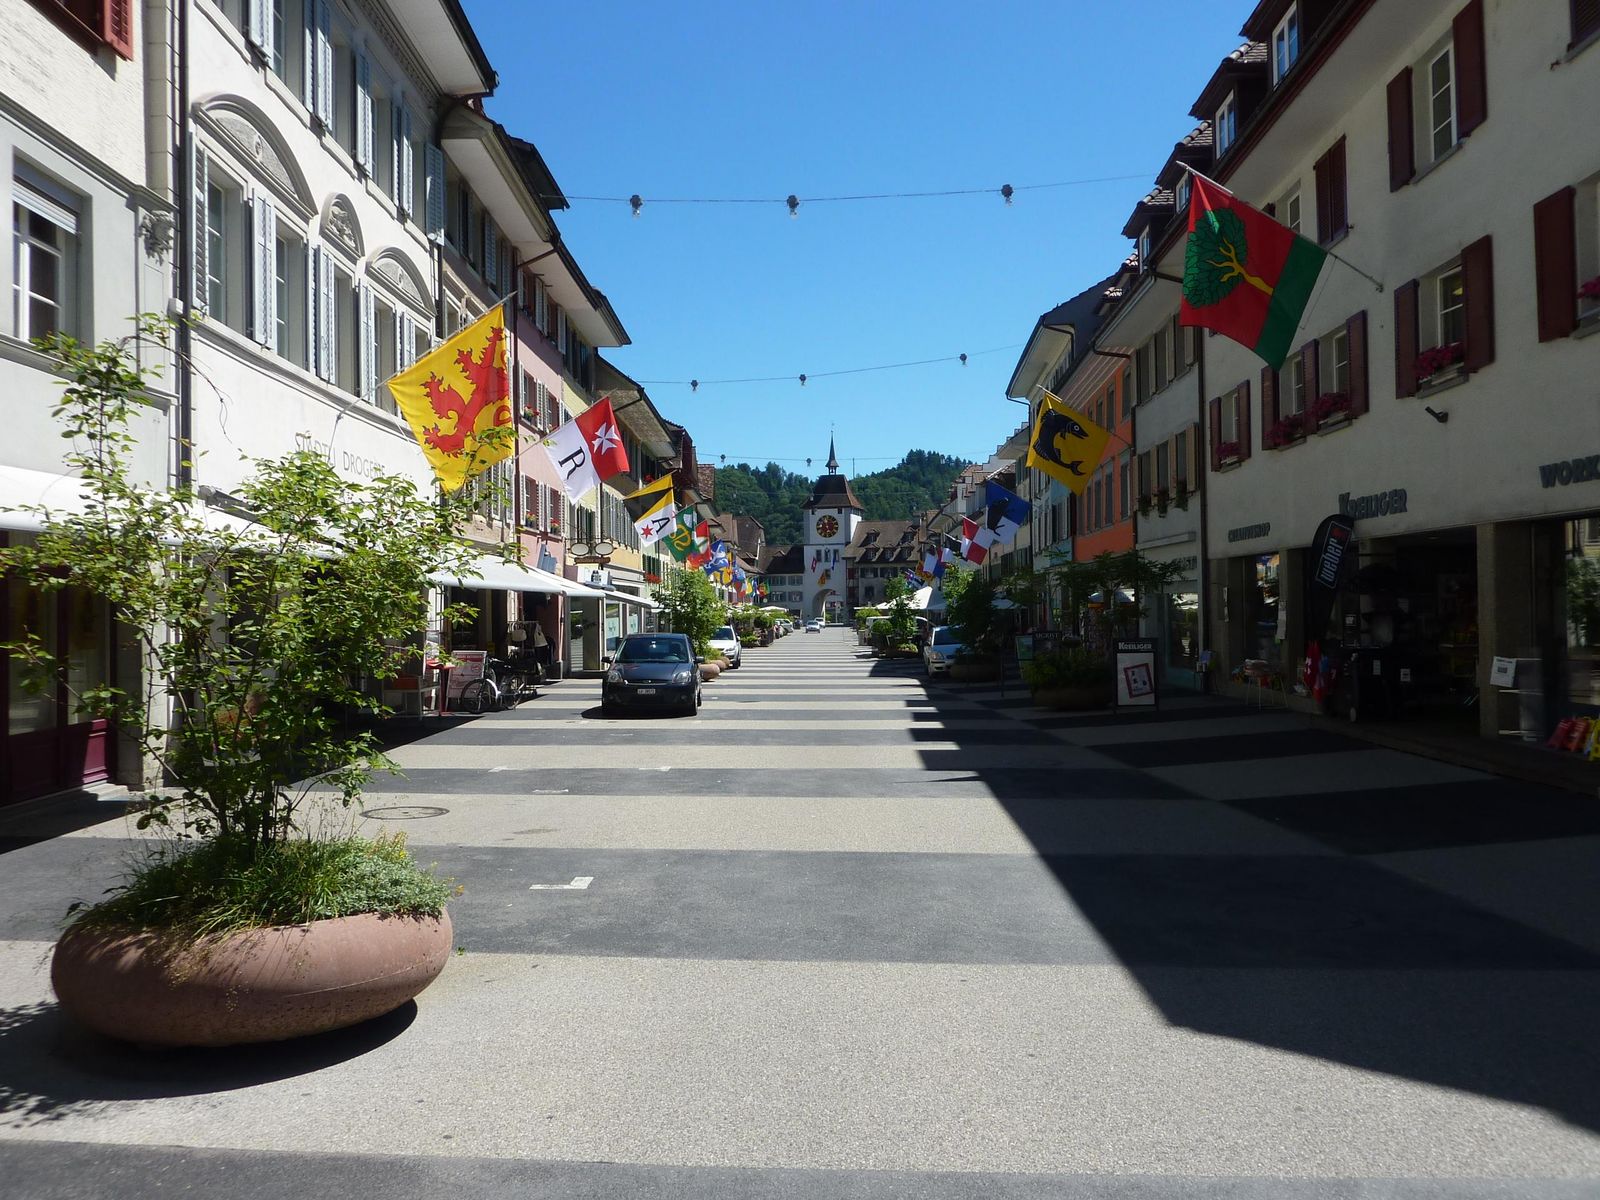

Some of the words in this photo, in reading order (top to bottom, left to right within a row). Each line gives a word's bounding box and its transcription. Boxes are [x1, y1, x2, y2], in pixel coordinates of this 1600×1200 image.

[343, 451, 386, 478] DROGERIE
[559, 446, 585, 480] R
[651, 516, 671, 534] A
[1320, 537, 1344, 582] weber
